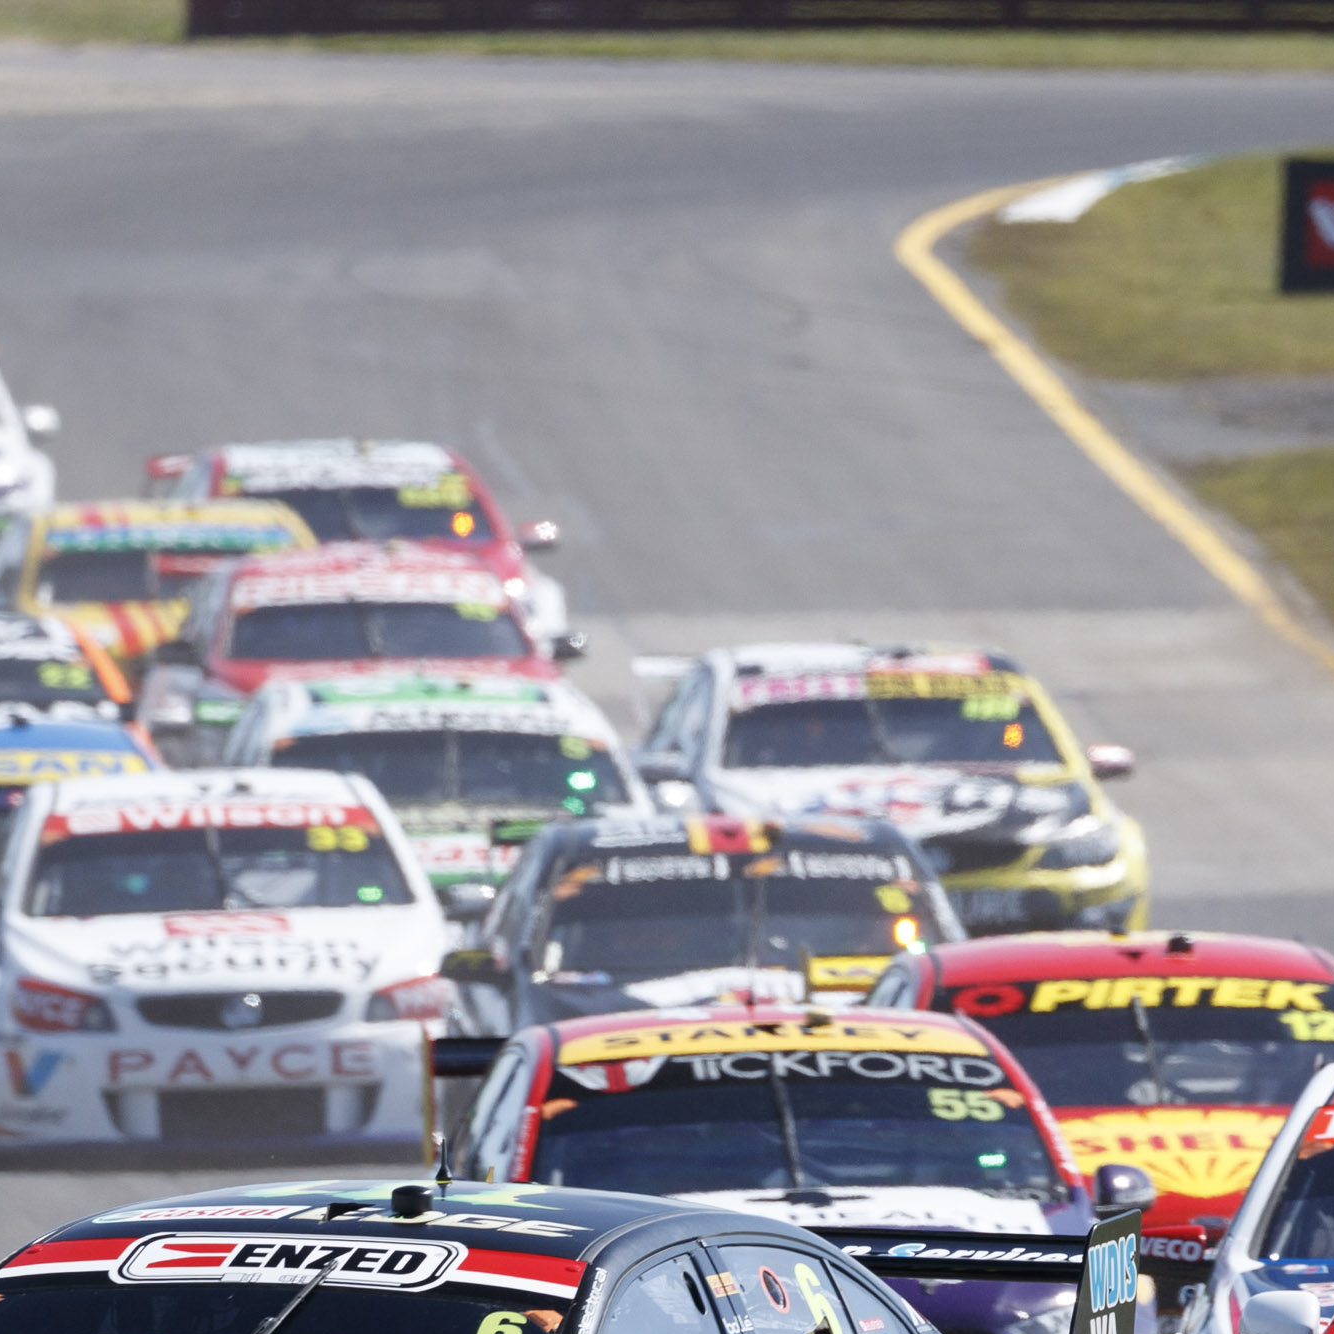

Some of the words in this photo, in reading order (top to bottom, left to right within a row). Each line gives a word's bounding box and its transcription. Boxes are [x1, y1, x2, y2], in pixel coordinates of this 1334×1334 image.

[1030, 976, 1331, 1013] PIRTEK
[108, 1041, 375, 1083] PAYCE
[929, 1088, 1005, 1122] 55
[1070, 1132, 1276, 1153] SHEL
[230, 1242, 433, 1275] ENZED
